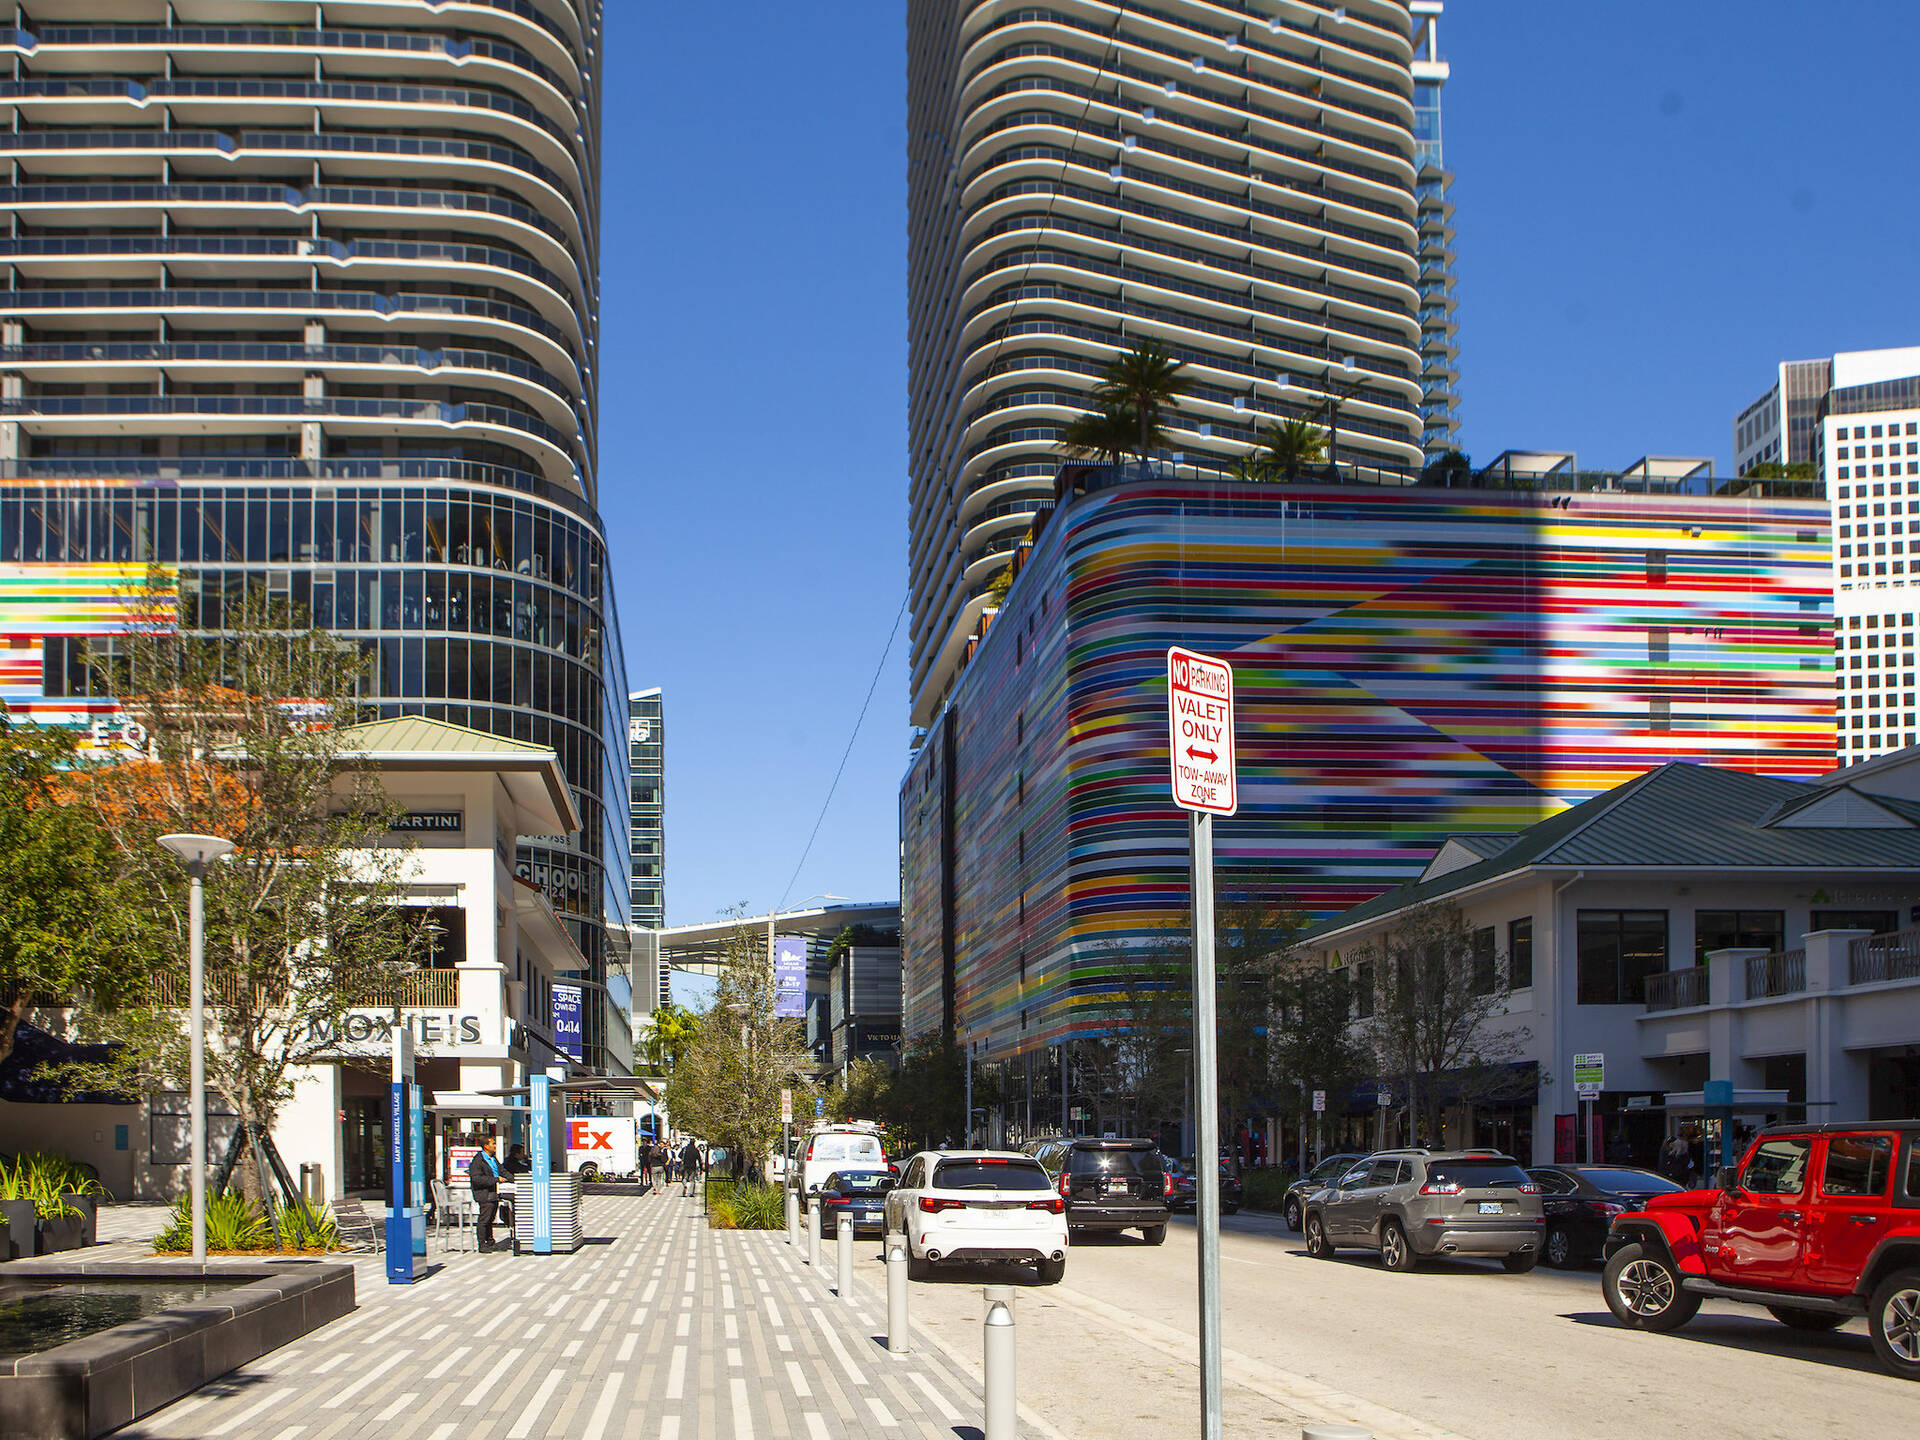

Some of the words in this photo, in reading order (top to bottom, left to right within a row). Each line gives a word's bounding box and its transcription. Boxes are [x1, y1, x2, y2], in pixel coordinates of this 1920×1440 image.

[1172, 659, 1188, 687] NO
[1191, 668, 1225, 693] PARKING
[1177, 696, 1226, 722] VALET
[1182, 720, 1222, 743] ONLY
[1178, 765, 1228, 786] TOW-AWAY
[1191, 784, 1217, 801] ZONE
[554, 1002, 577, 1012] OWNER
[557, 992, 581, 1005] SPACE
[409, 1113, 418, 1176] VALET
[535, 1114, 545, 1177] VALET
